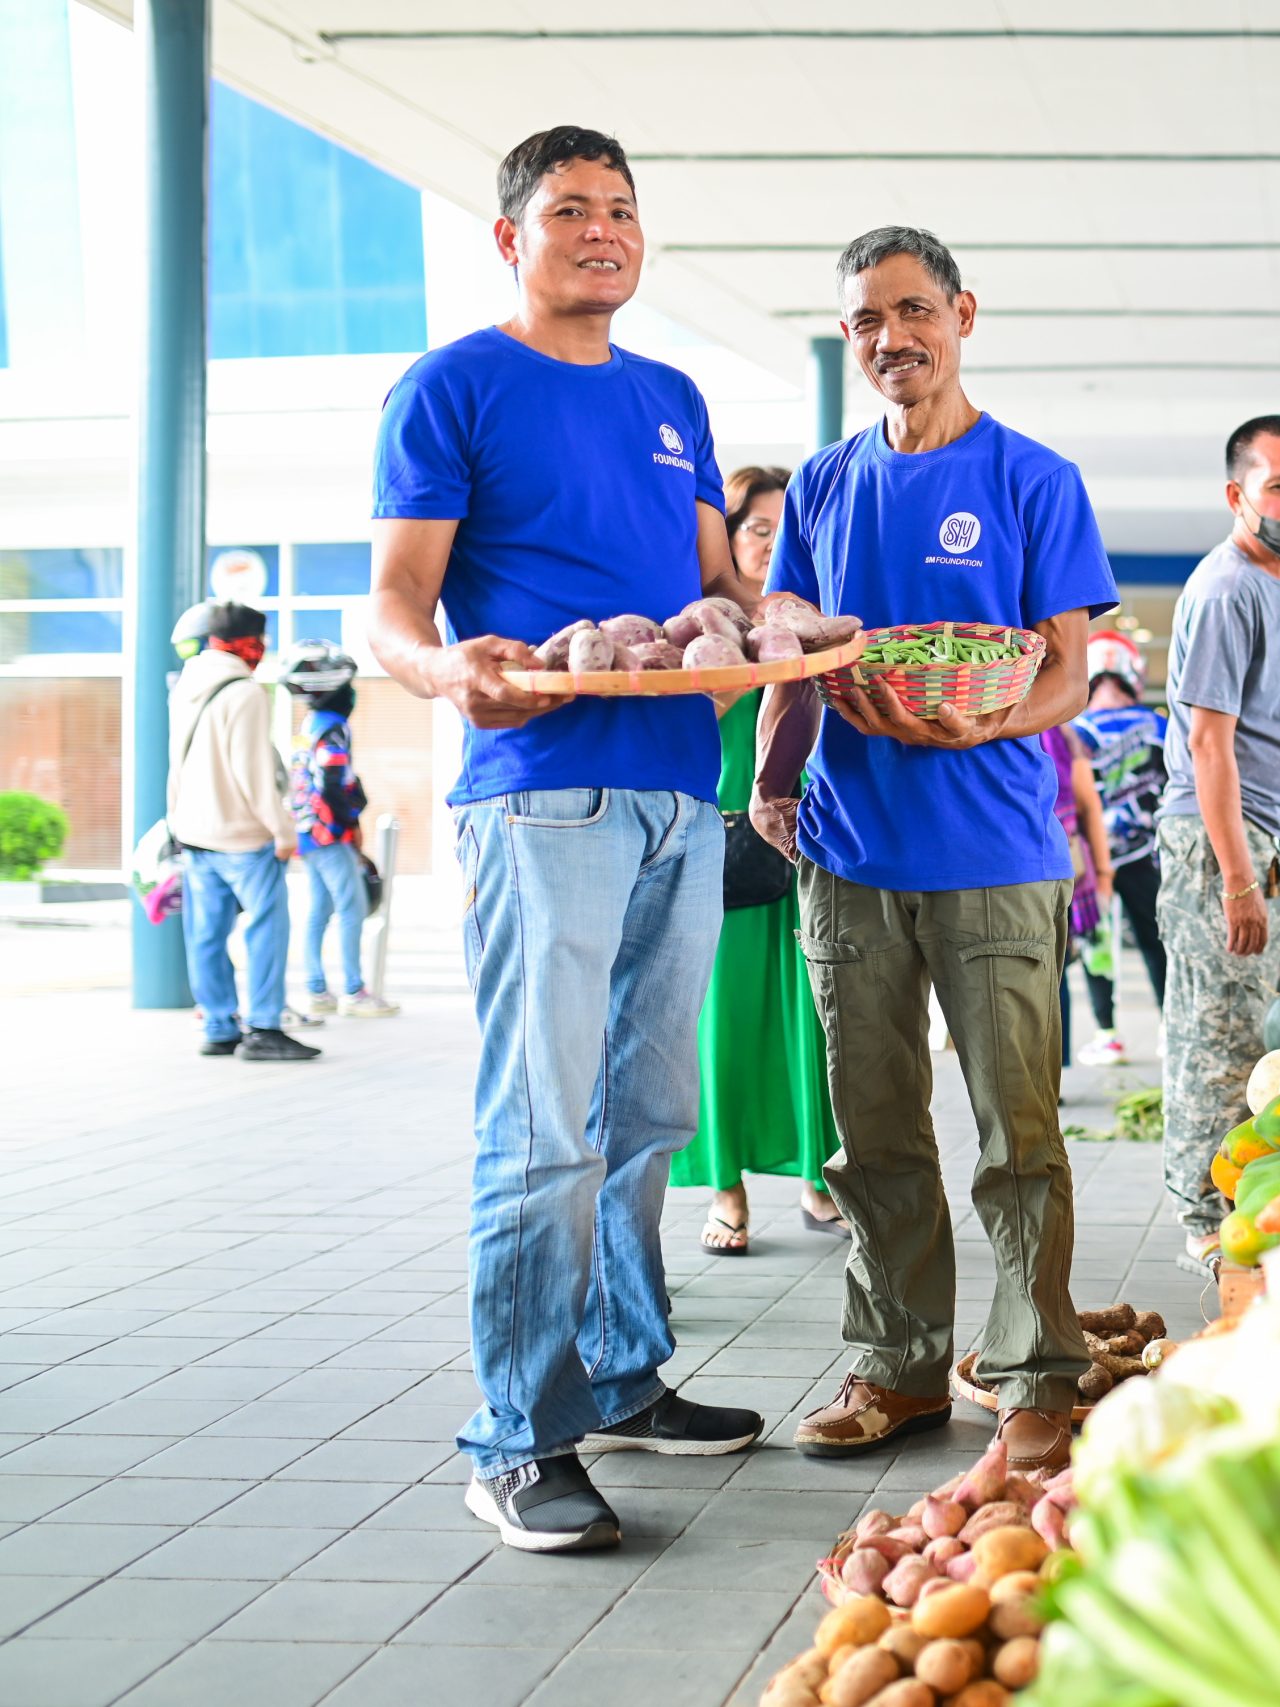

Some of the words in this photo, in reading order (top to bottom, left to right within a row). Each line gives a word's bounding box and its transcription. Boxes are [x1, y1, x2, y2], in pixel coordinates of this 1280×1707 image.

[653, 453, 695, 475] FOUNDATION
[943, 518, 976, 548] SM
[935, 557, 983, 568] FOUNDATION
